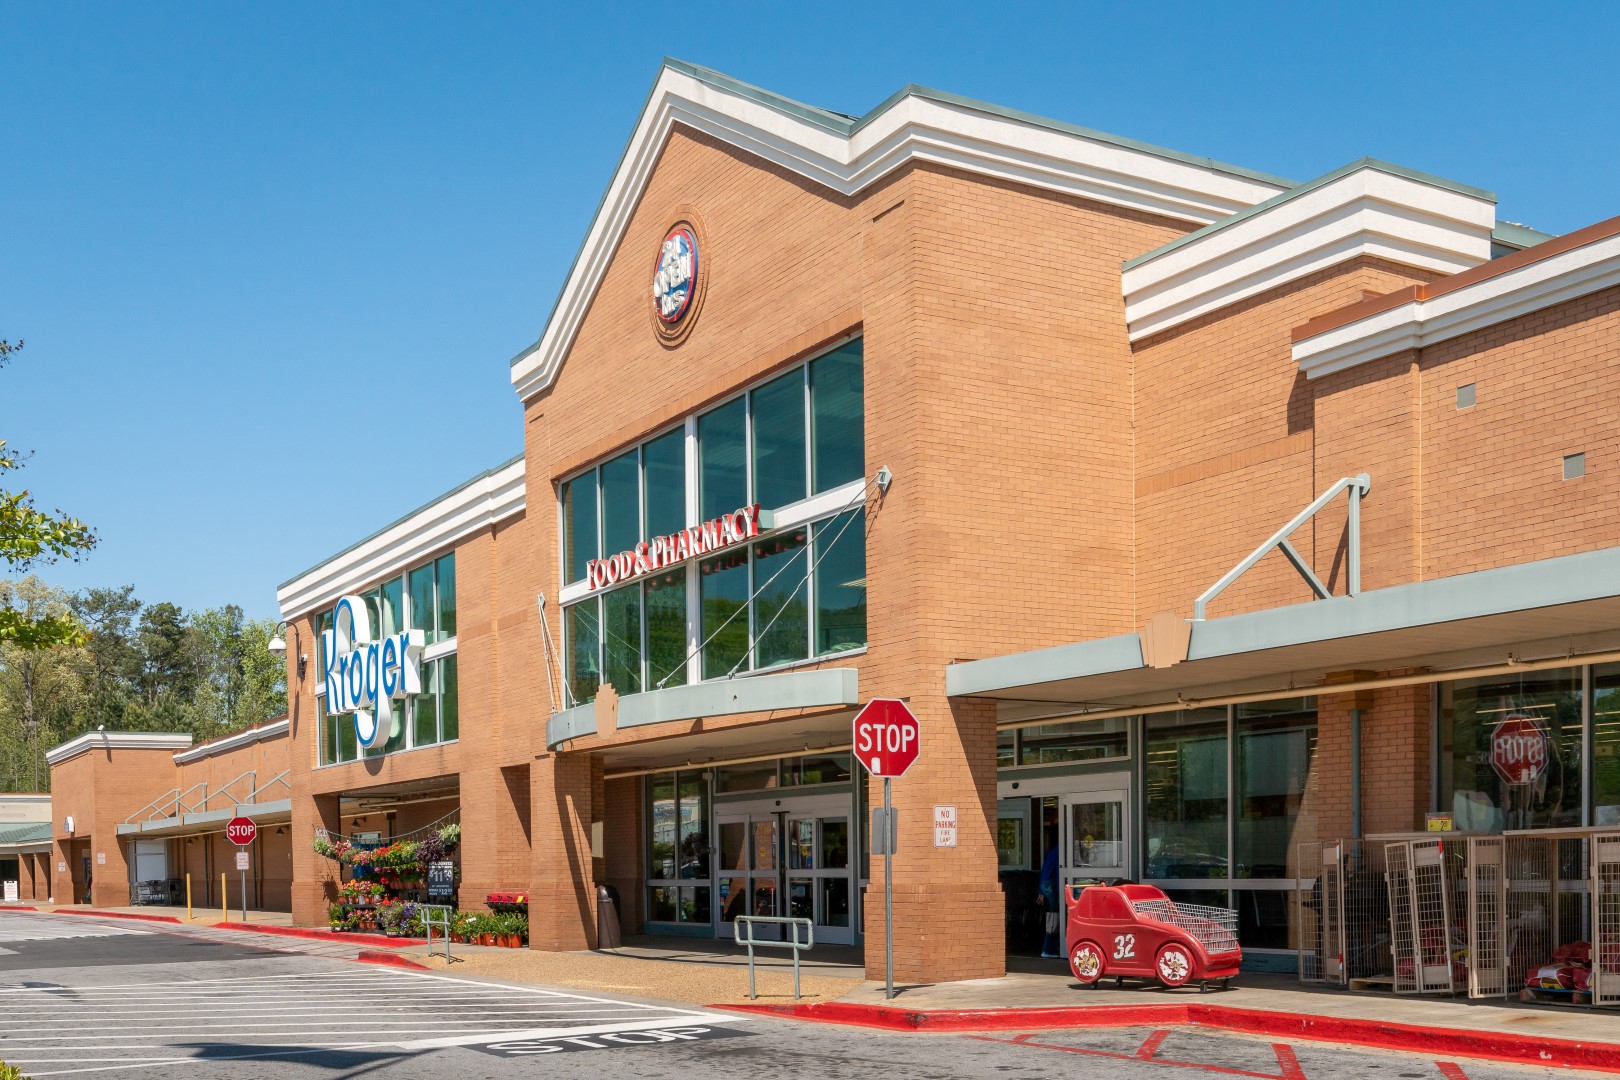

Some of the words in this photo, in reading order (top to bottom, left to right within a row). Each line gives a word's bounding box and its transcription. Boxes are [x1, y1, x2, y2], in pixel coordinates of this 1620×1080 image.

[654, 252, 692, 298] OPEN
[586, 550, 634, 590] FOOD
[634, 541, 651, 576] &
[652, 503, 760, 569] PHARMACY
[322, 597, 411, 748] Kroger
[858, 723, 916, 753] STOP
[935, 820, 956, 829] PARKING
[940, 810, 950, 819] NO
[229, 825, 254, 836] STOP
[1113, 933, 1136, 959] 32
[486, 1027, 711, 1054] STOP
